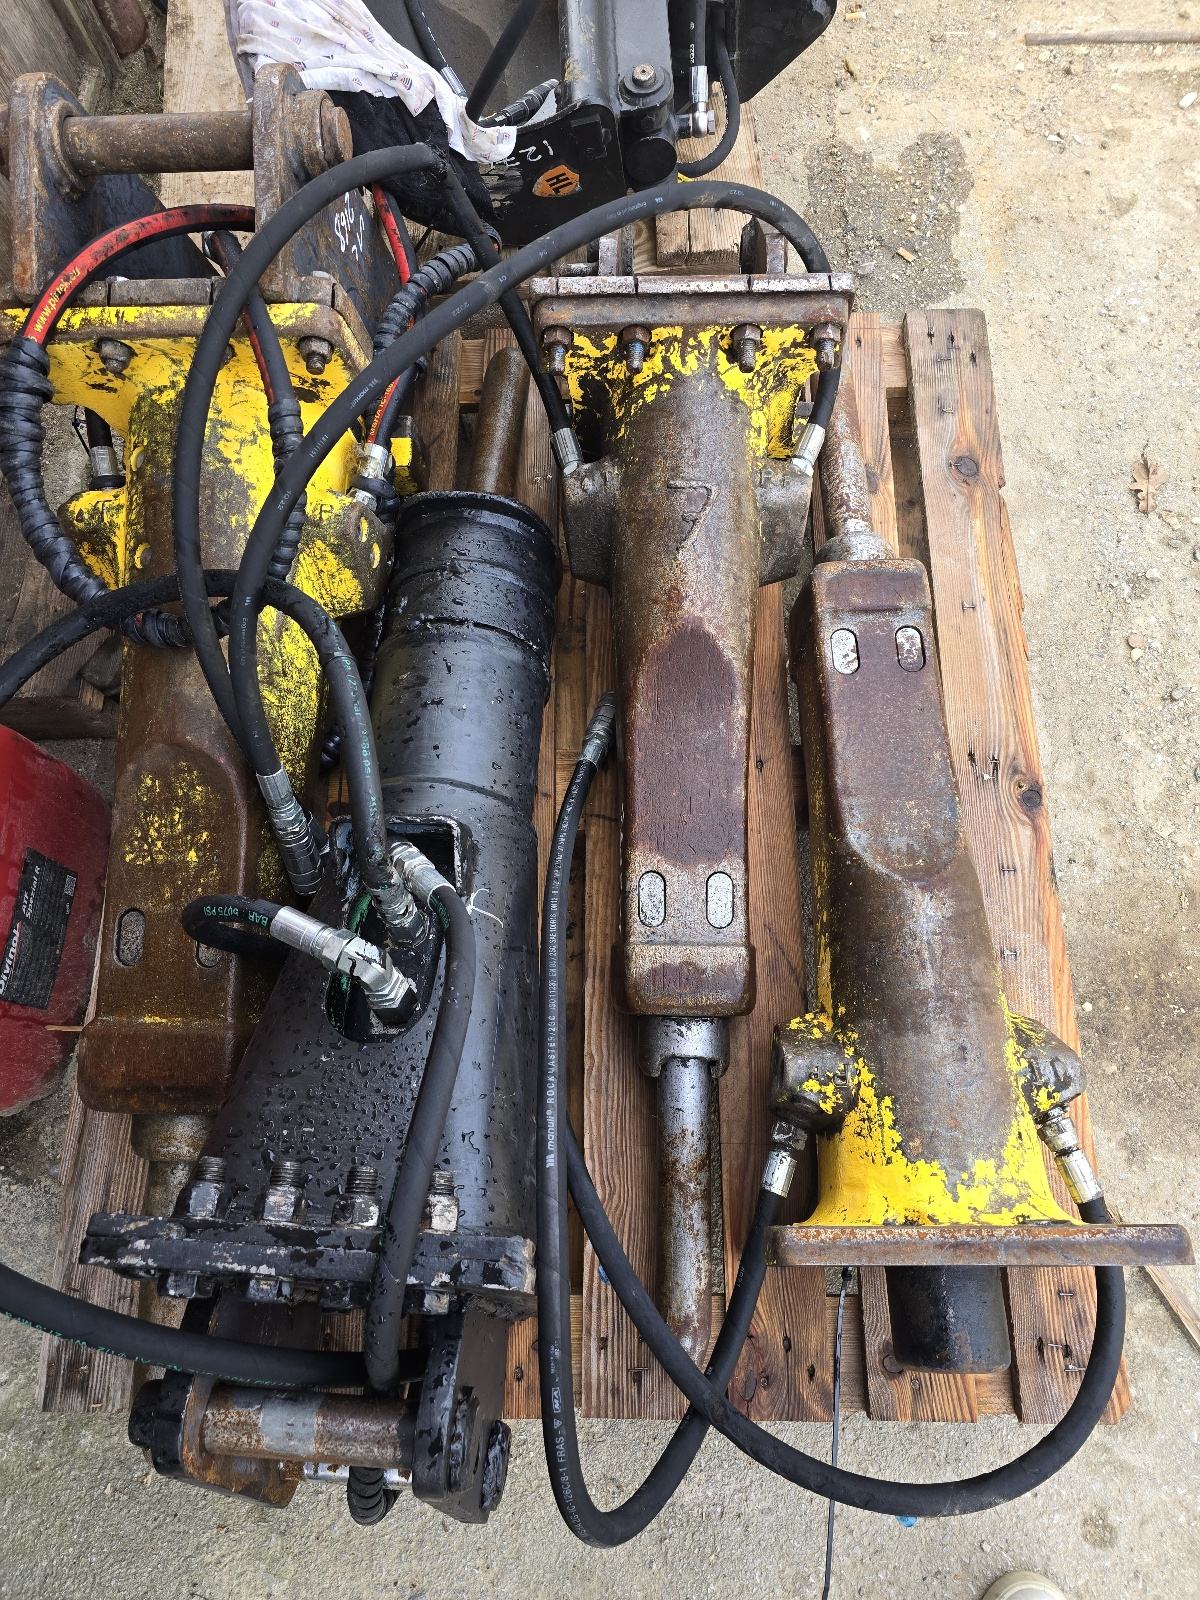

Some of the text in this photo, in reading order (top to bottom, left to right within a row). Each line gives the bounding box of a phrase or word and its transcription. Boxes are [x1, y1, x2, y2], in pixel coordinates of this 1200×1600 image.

[545, 172, 574, 195] HL
[21, 890, 30, 915] ATF
[25, 875, 38, 920] Spezial
[248, 910, 269, 927] BAR
[0, 927, 20, 995] Divinol
[557, 1436, 566, 1463] FRAS
